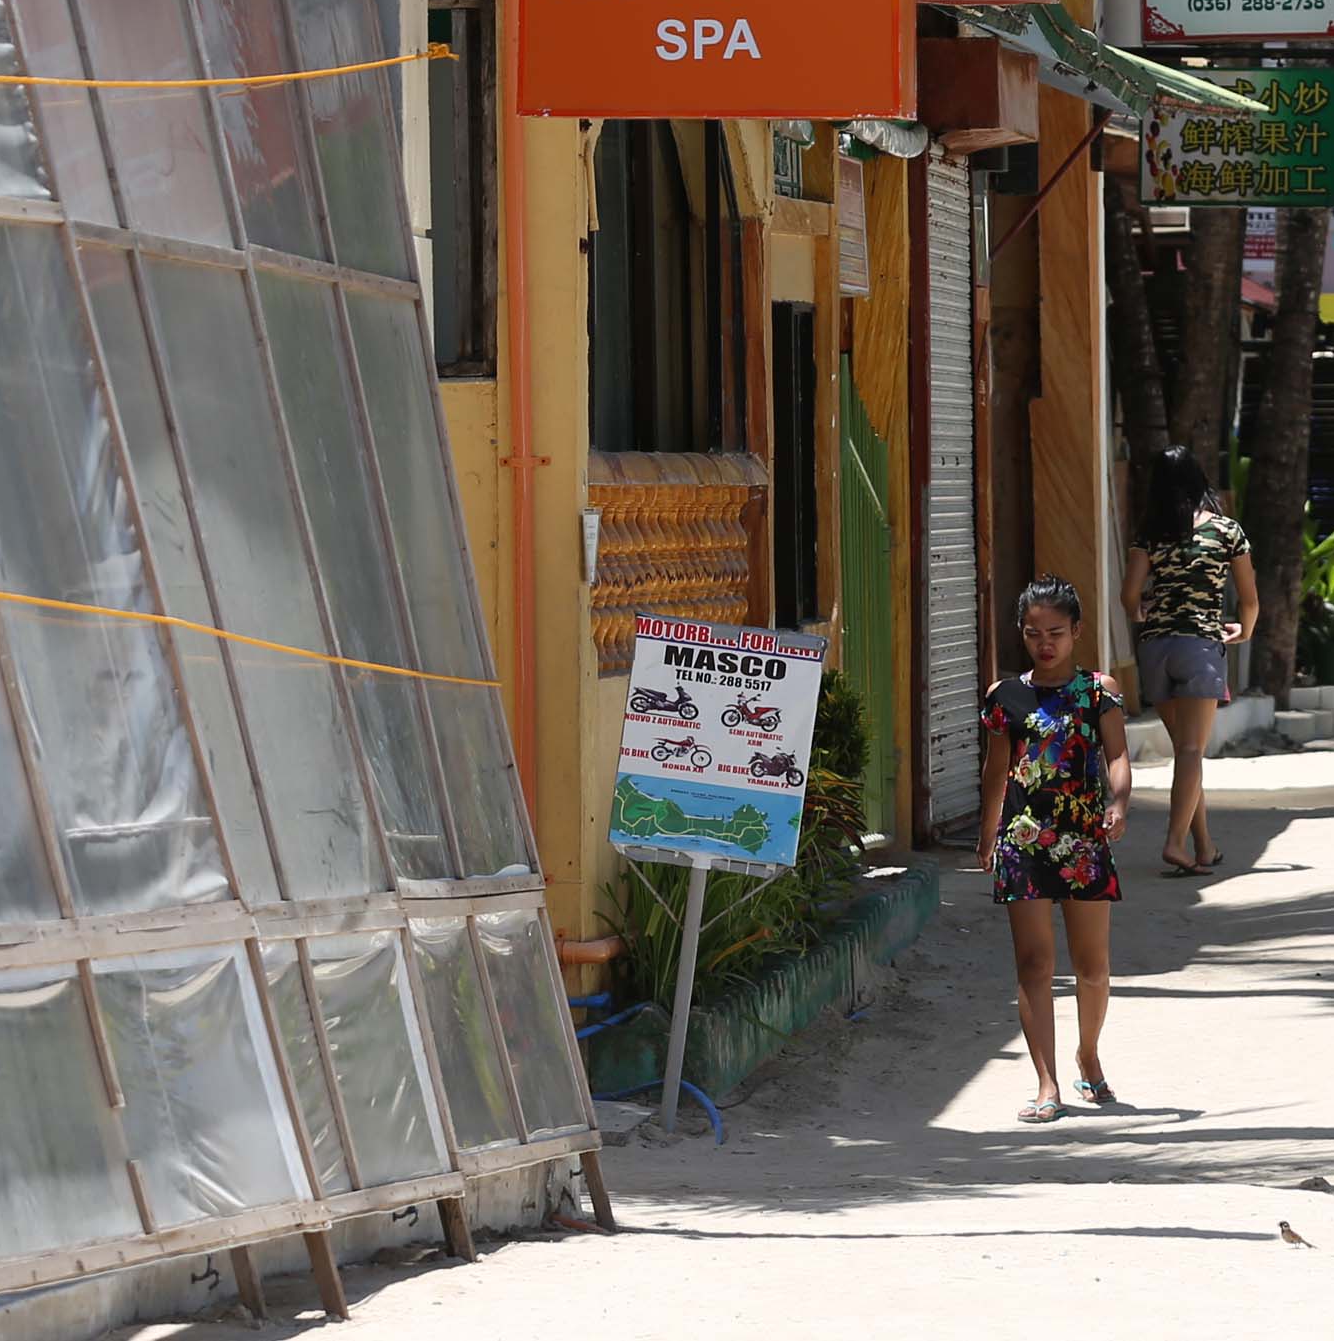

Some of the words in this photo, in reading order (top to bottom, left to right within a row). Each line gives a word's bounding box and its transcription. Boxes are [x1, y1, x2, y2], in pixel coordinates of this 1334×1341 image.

[656, 19, 761, 61] SPA
[636, 617, 737, 647] MOTORB
[740, 632, 774, 651] FOR
[664, 645, 787, 680] MASCO
[675, 669, 693, 682] TEL
[719, 675, 742, 689] 288
[745, 678, 771, 692] 5517
[657, 717, 701, 730] AUTOMATIC
[632, 748, 650, 758] BIKE
